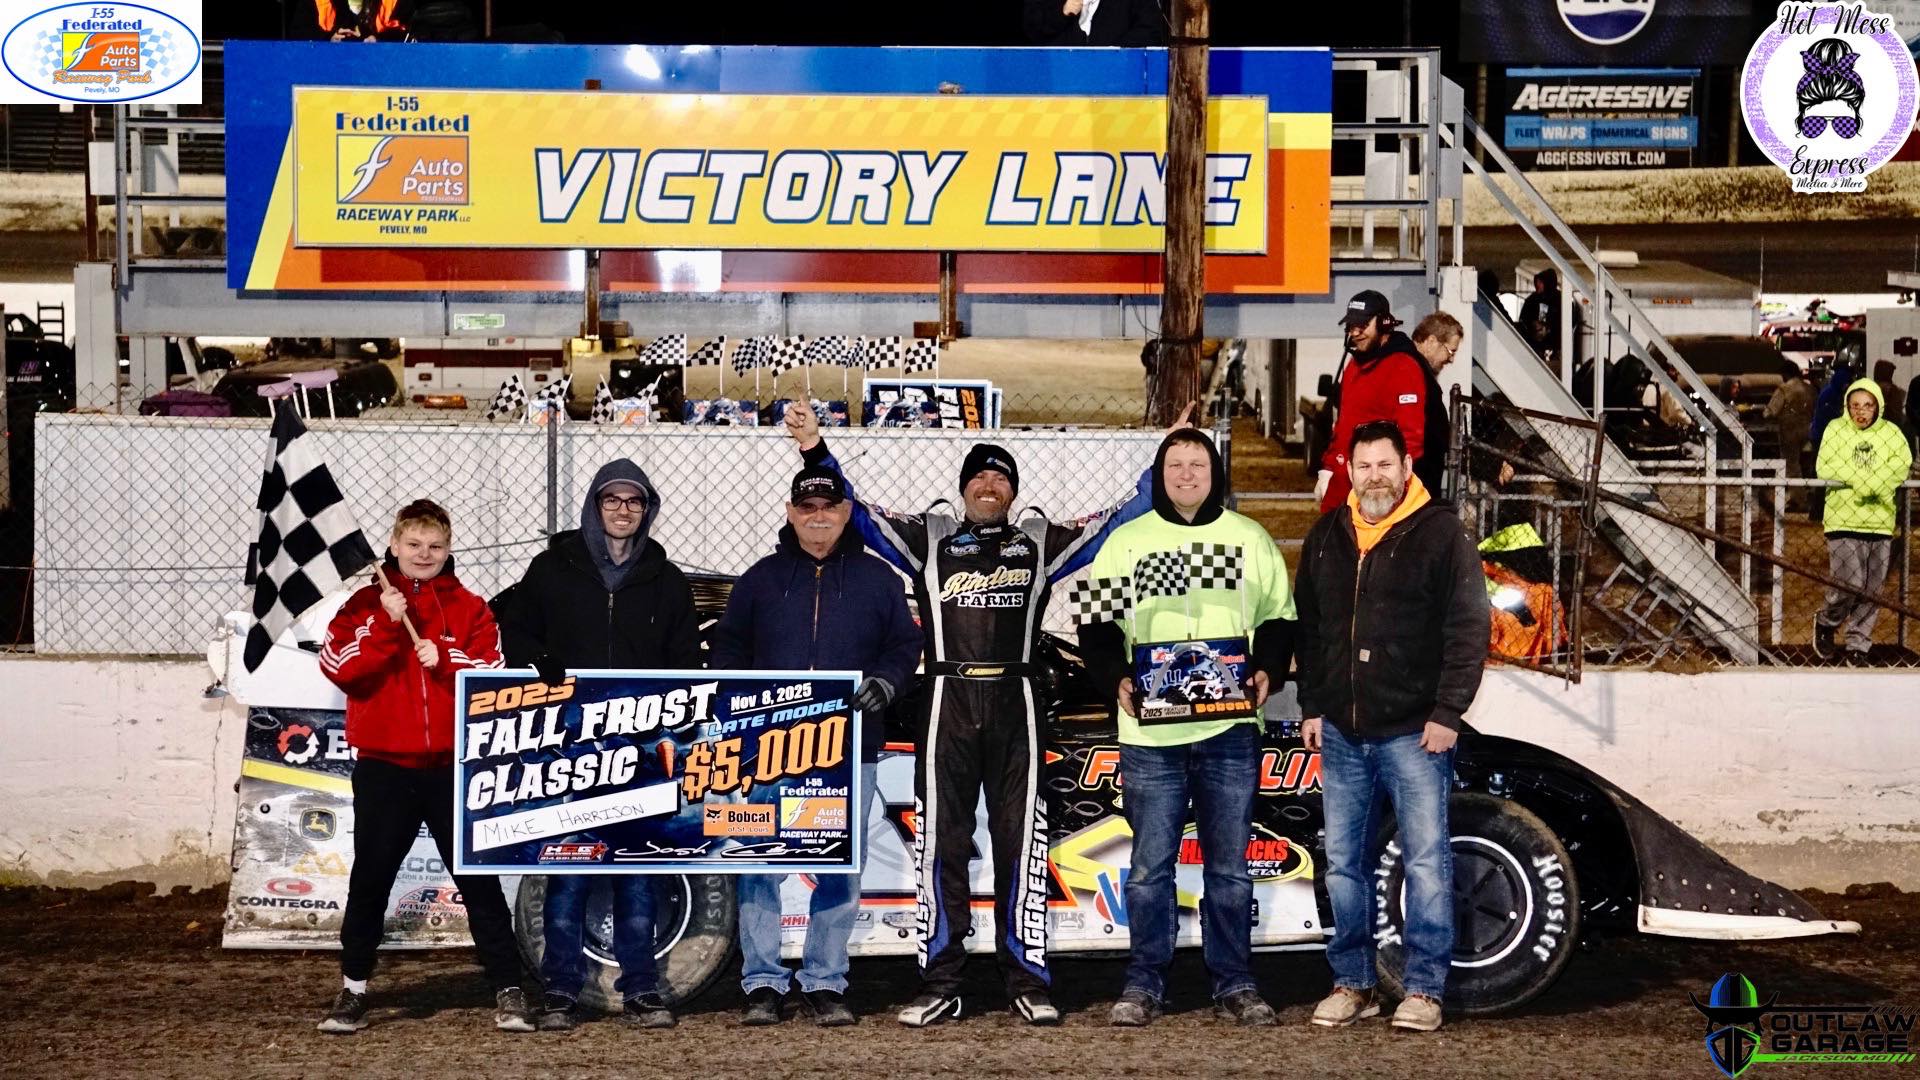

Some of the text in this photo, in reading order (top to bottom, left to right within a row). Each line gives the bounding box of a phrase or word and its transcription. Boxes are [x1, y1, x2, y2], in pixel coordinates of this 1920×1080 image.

[387, 96, 419, 111] I-55
[1512, 83, 1692, 110] AGGRESSIVE
[336, 113, 470, 133] Federated
[1515, 128, 1540, 138] FLEET
[1542, 126, 1586, 140] WRAPS
[1652, 126, 1688, 140] SIGNS
[1536, 151, 1666, 166] AGGRESSIVESTL.COM
[411, 158, 465, 177] Auto
[402, 177, 465, 197] Parts
[534, 147, 968, 225] VICTORY
[336, 208, 413, 222] RACEWAY
[417, 209, 459, 222] PARK
[413, 226, 427, 235] MO
[957, 592, 1024, 608] FARMS
[468, 676, 577, 717] 2025
[731, 682, 812, 712] Nov 8, 2025
[708, 698, 849, 737] LATE MODEL
[1144, 708, 1163, 717] 2025
[459, 681, 718, 763] FALL FROST
[682, 716, 848, 801] $5,000
[466, 745, 639, 811] CLASSIC
[806, 778, 823, 787] I-55
[780, 786, 848, 796] Federated
[728, 810, 770, 823] Bobcat
[818, 808, 845, 816] Auto
[484, 803, 645, 844] MIKE HARRISON
[813, 816, 845, 826] Parts
[780, 831, 819, 839] RACEWAY
[820, 831, 843, 839] PARK
[1023, 795, 1050, 968] AGGRESSIVE
[237, 896, 339, 910] CONTEGRA
